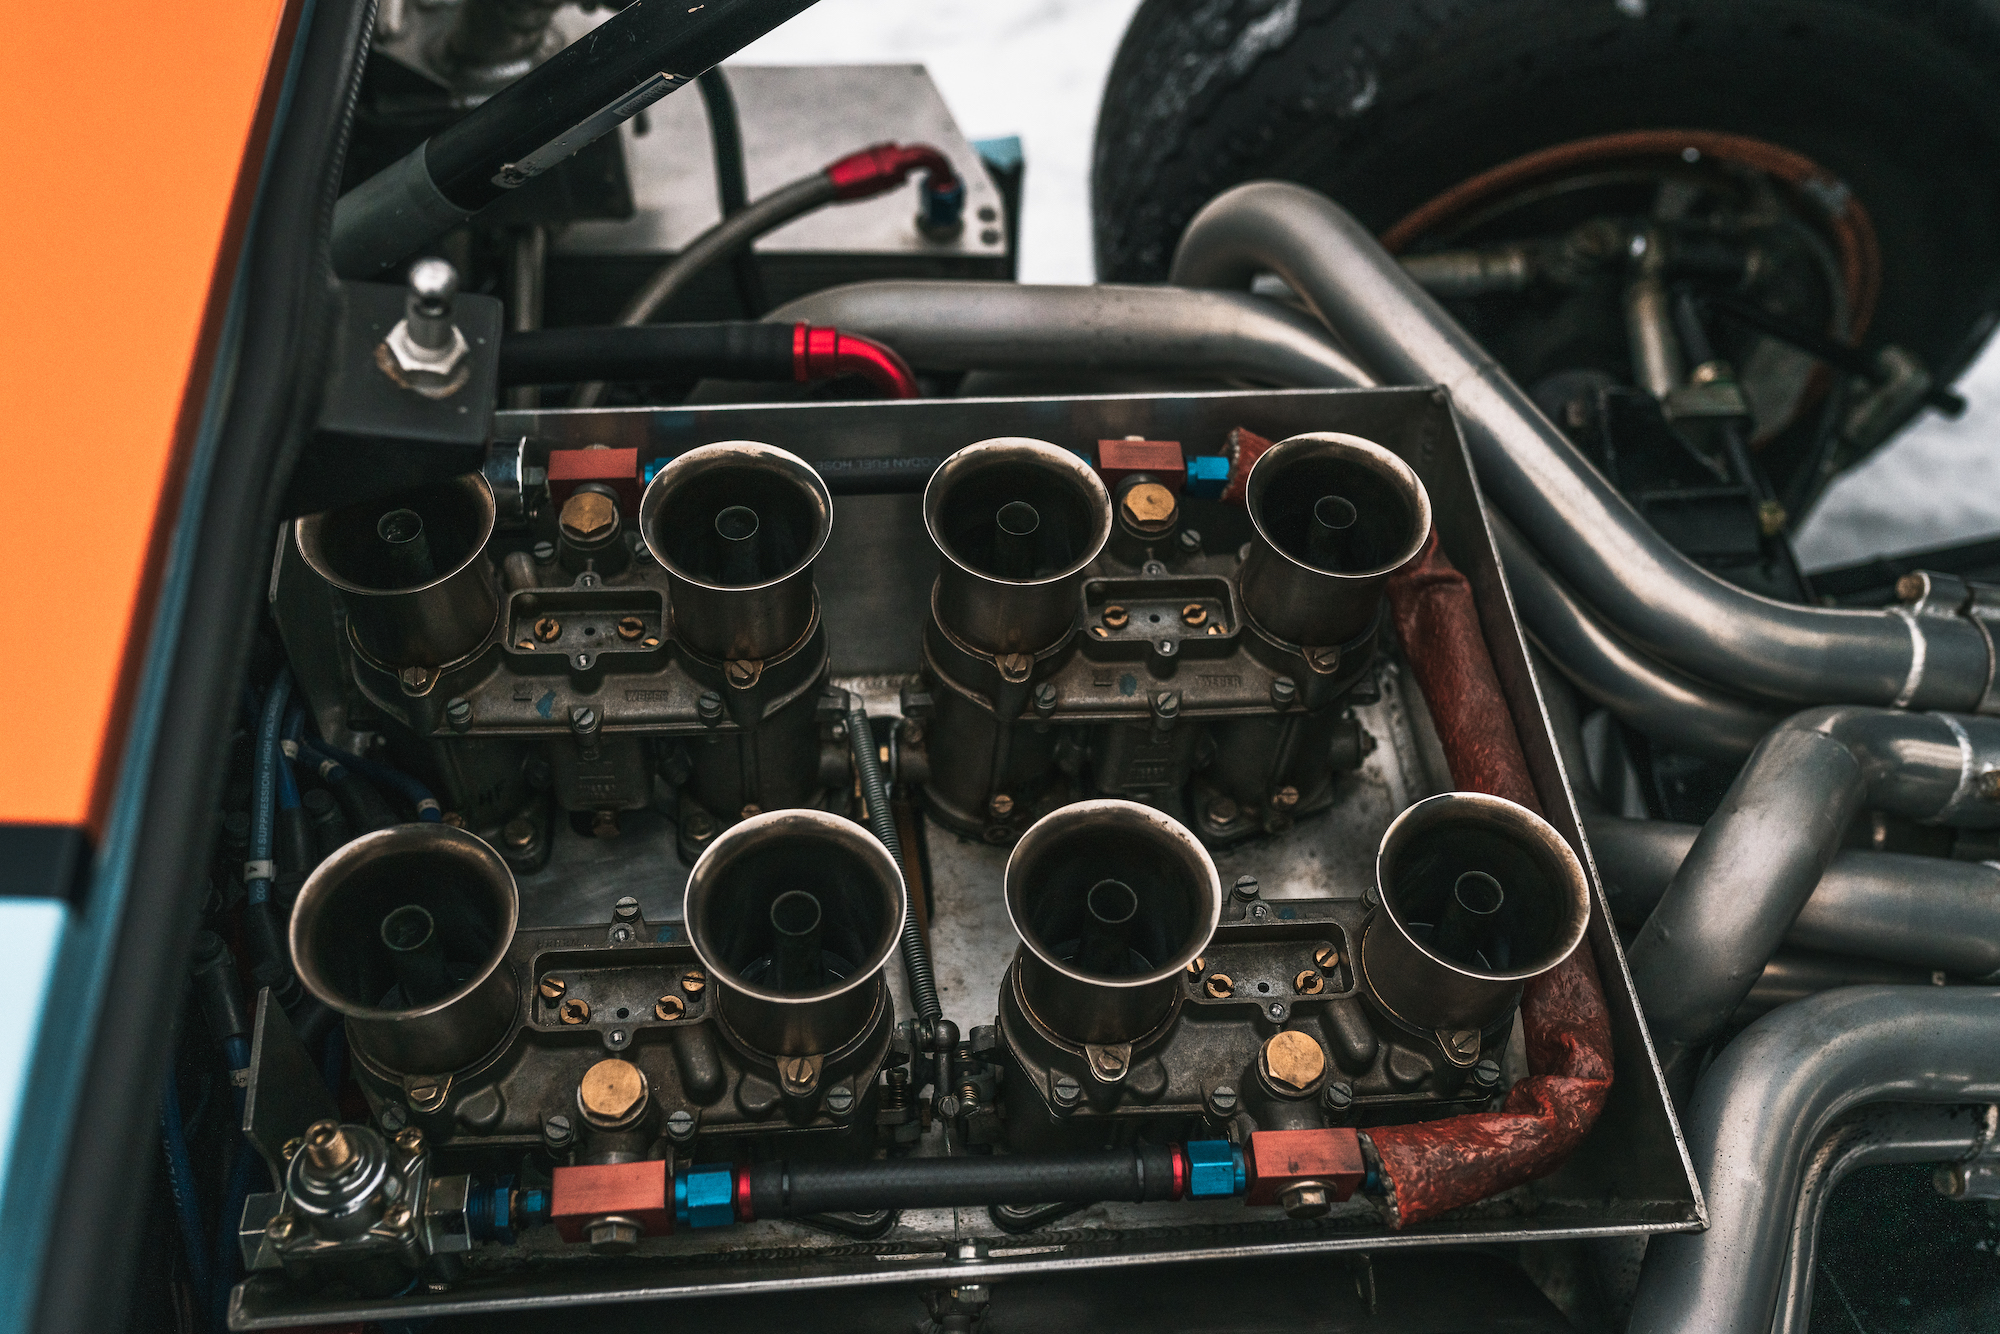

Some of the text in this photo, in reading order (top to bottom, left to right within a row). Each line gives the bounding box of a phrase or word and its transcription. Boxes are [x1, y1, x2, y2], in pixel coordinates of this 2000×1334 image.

[815, 457, 940, 471] CODAN FUEL HOSE
[1195, 674, 1243, 688] WEBER
[624, 689, 669, 702] WEBER
[263, 740, 273, 765] HIGH
[258, 771, 271, 845] SUPPRESSION
